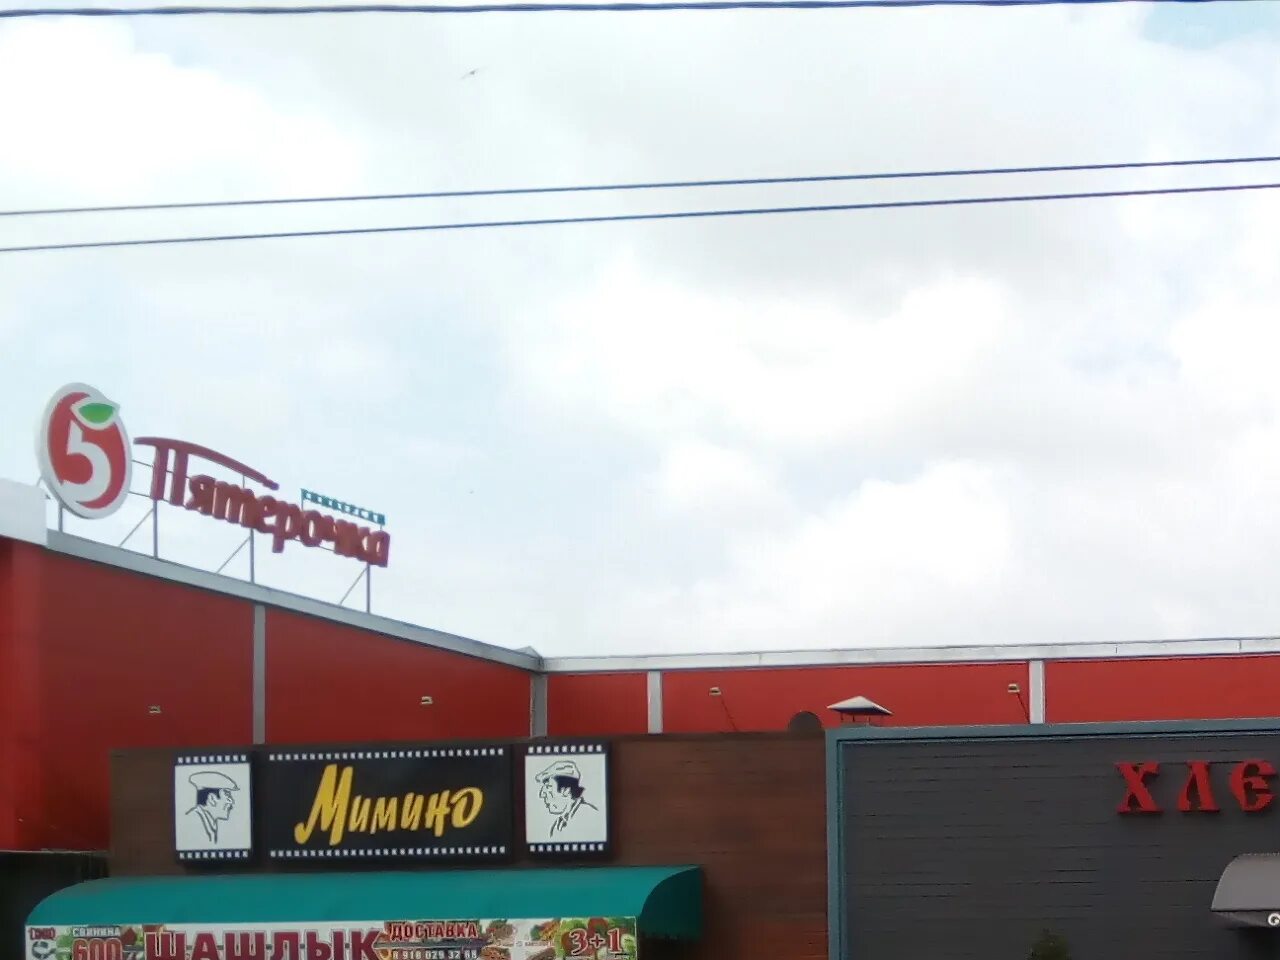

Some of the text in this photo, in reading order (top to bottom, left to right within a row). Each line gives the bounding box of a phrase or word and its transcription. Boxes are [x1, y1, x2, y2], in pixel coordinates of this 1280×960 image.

[294, 763, 484, 846] Мимино
[389, 922, 479, 942] ДОСТАВКА
[568, 927, 623, 956] 3+1
